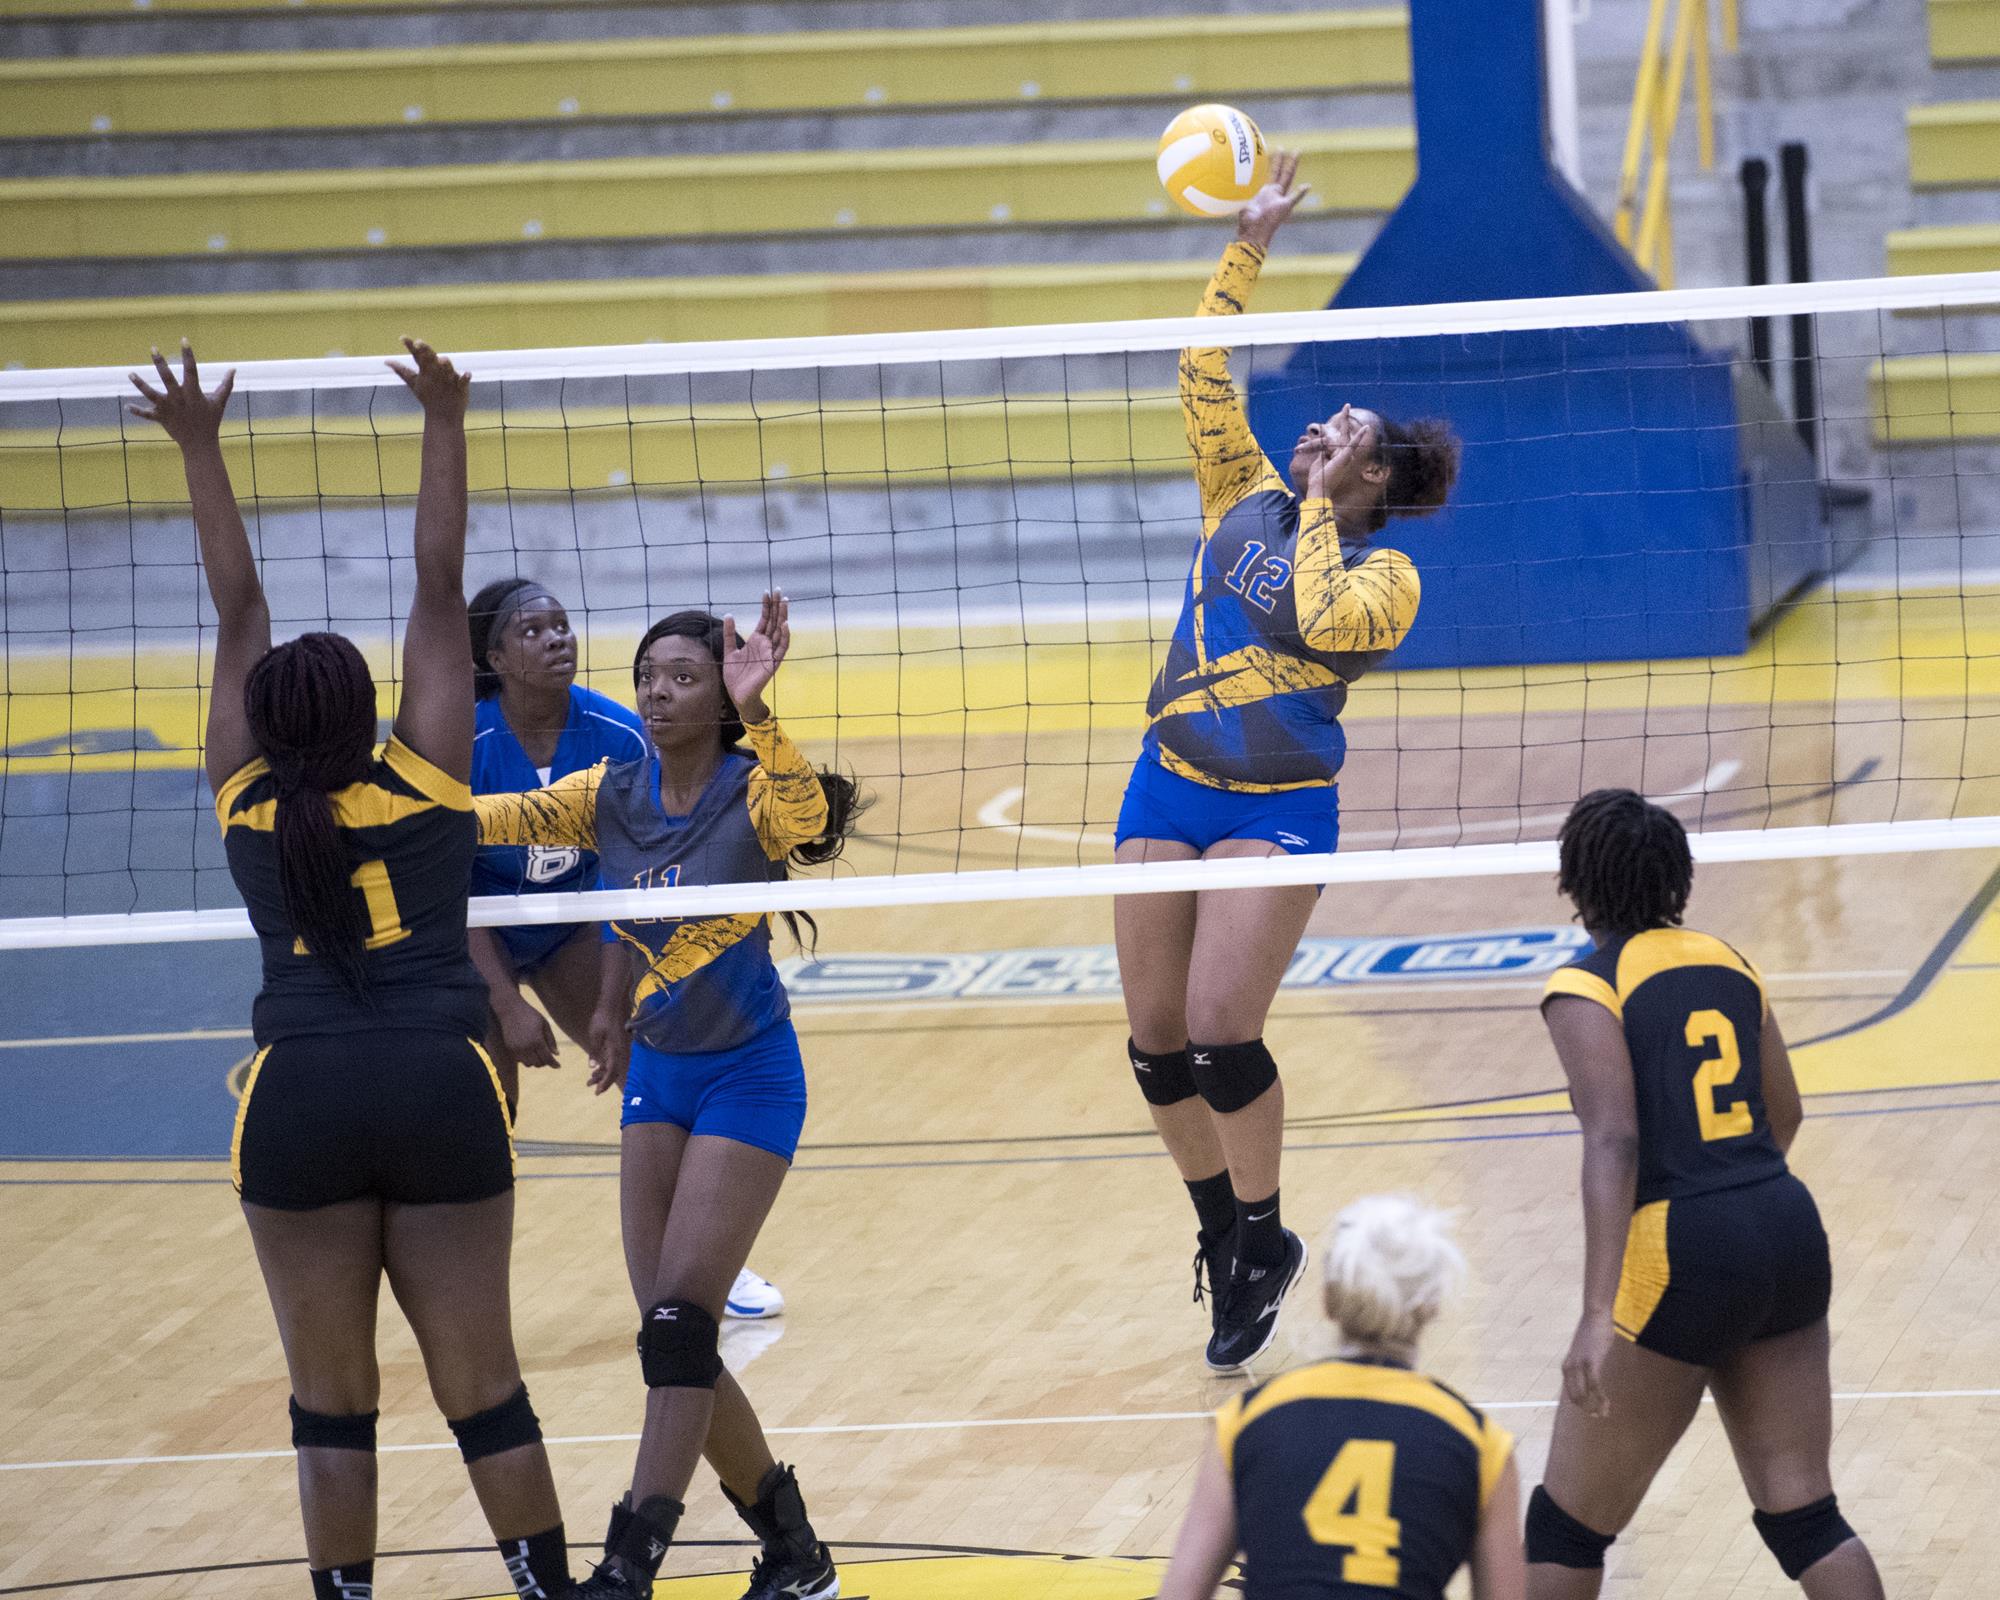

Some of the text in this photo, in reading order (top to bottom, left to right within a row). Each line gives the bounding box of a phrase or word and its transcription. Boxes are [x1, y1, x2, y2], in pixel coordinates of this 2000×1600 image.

[1229, 112, 1251, 165] SPALD
[1224, 540, 1293, 615] 12
[526, 844, 580, 884] 8
[1684, 1008, 1754, 1142] 2
[1302, 1437, 1402, 1588] 4
